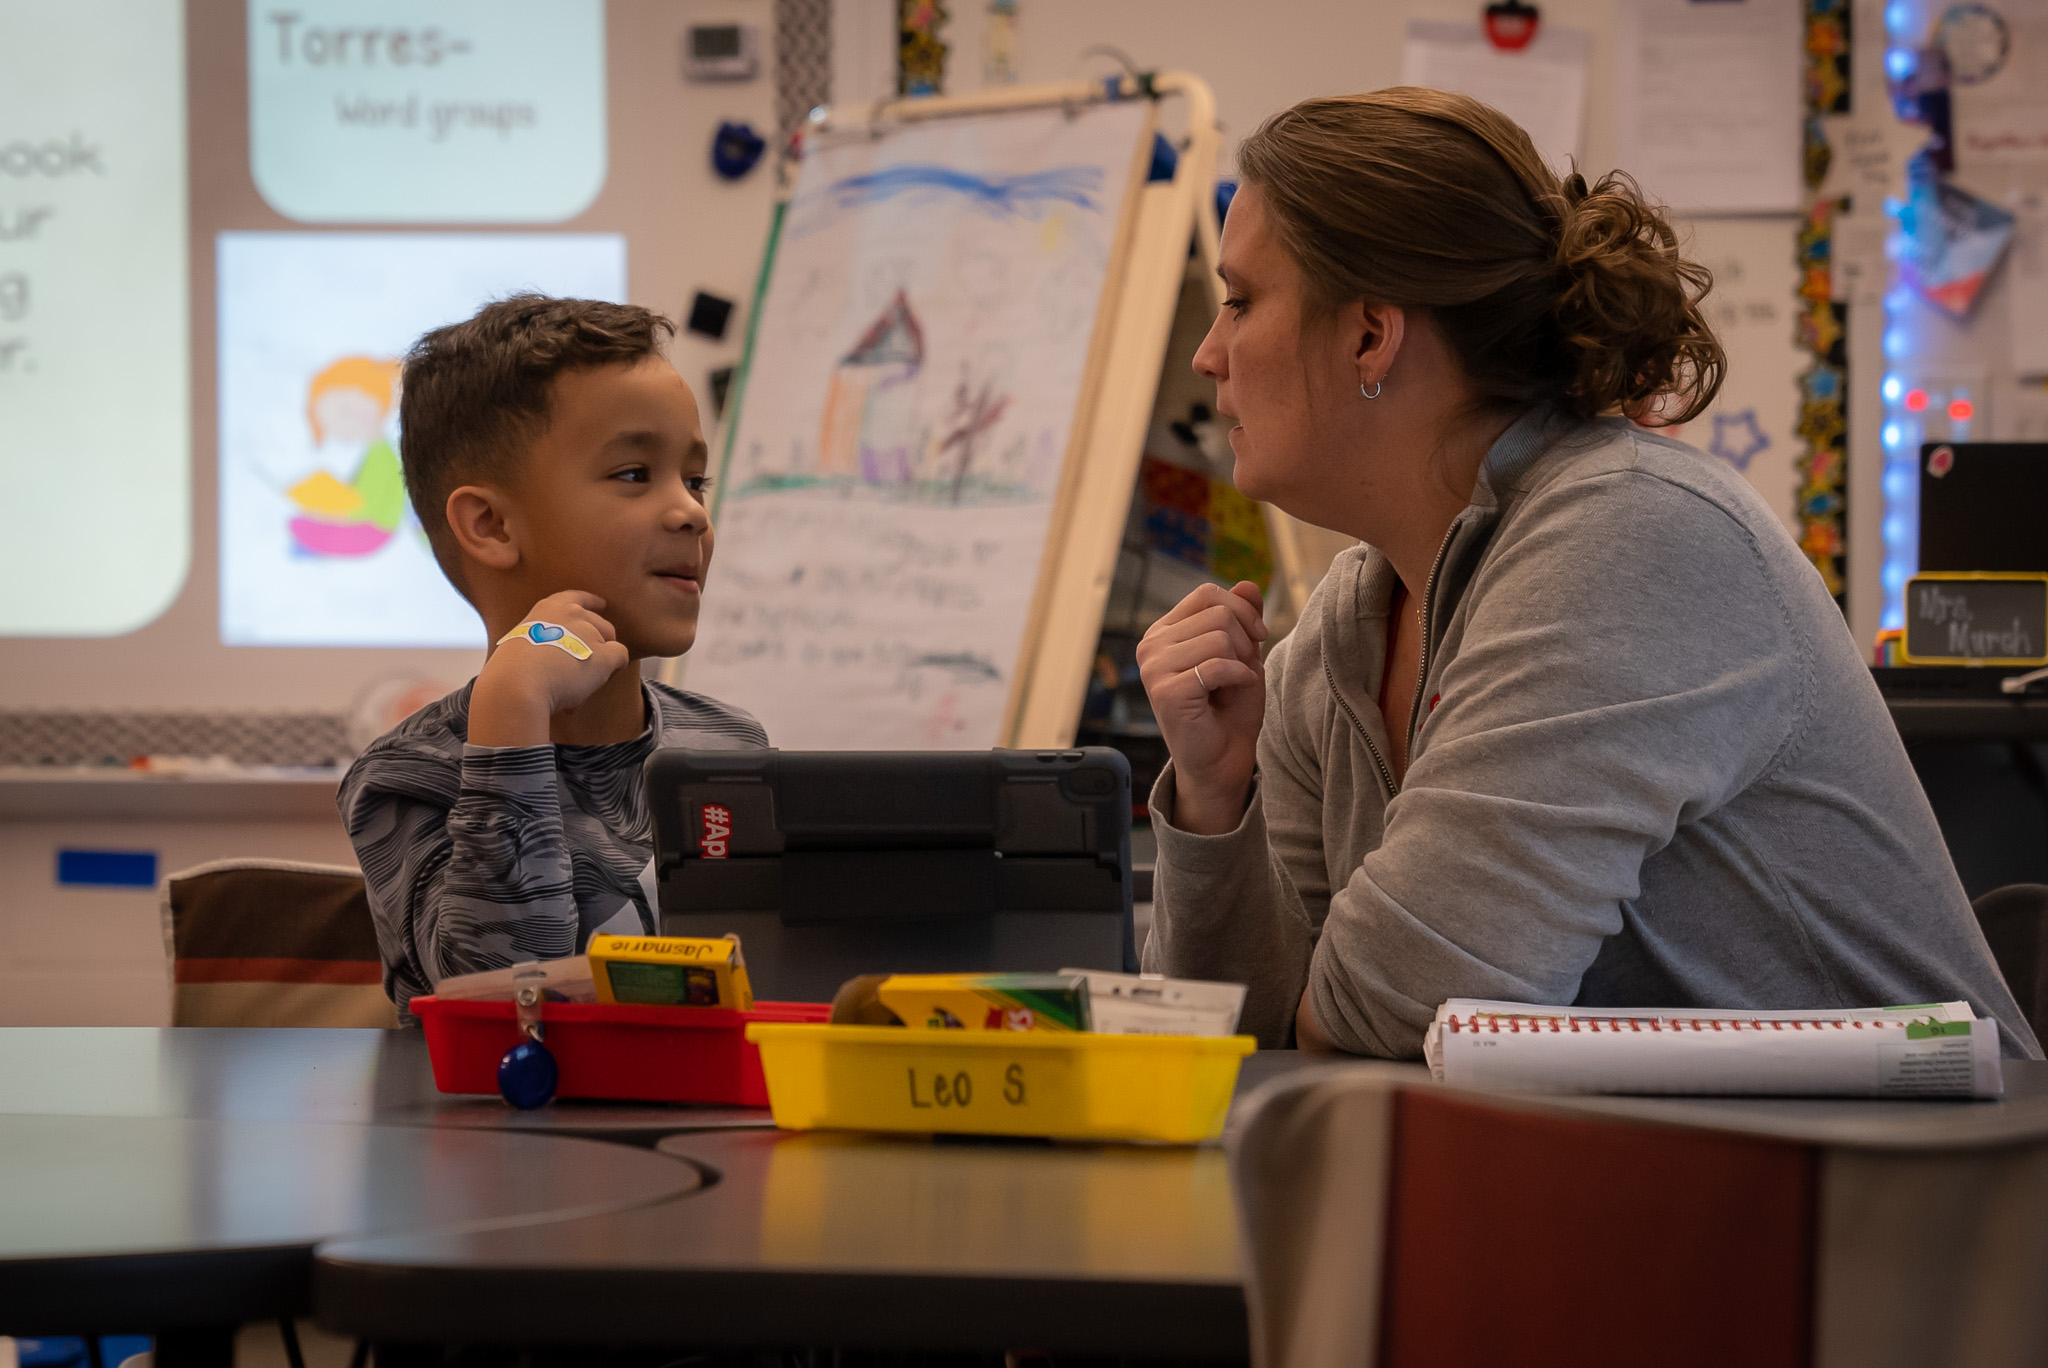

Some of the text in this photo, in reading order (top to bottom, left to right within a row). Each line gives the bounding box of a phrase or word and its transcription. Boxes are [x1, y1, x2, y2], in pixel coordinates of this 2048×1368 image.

[266, 9, 473, 67] Torres-
[429, 99, 537, 142] groups
[702, 807, 729, 858] #Ap
[908, 1067, 972, 1108] Leo
